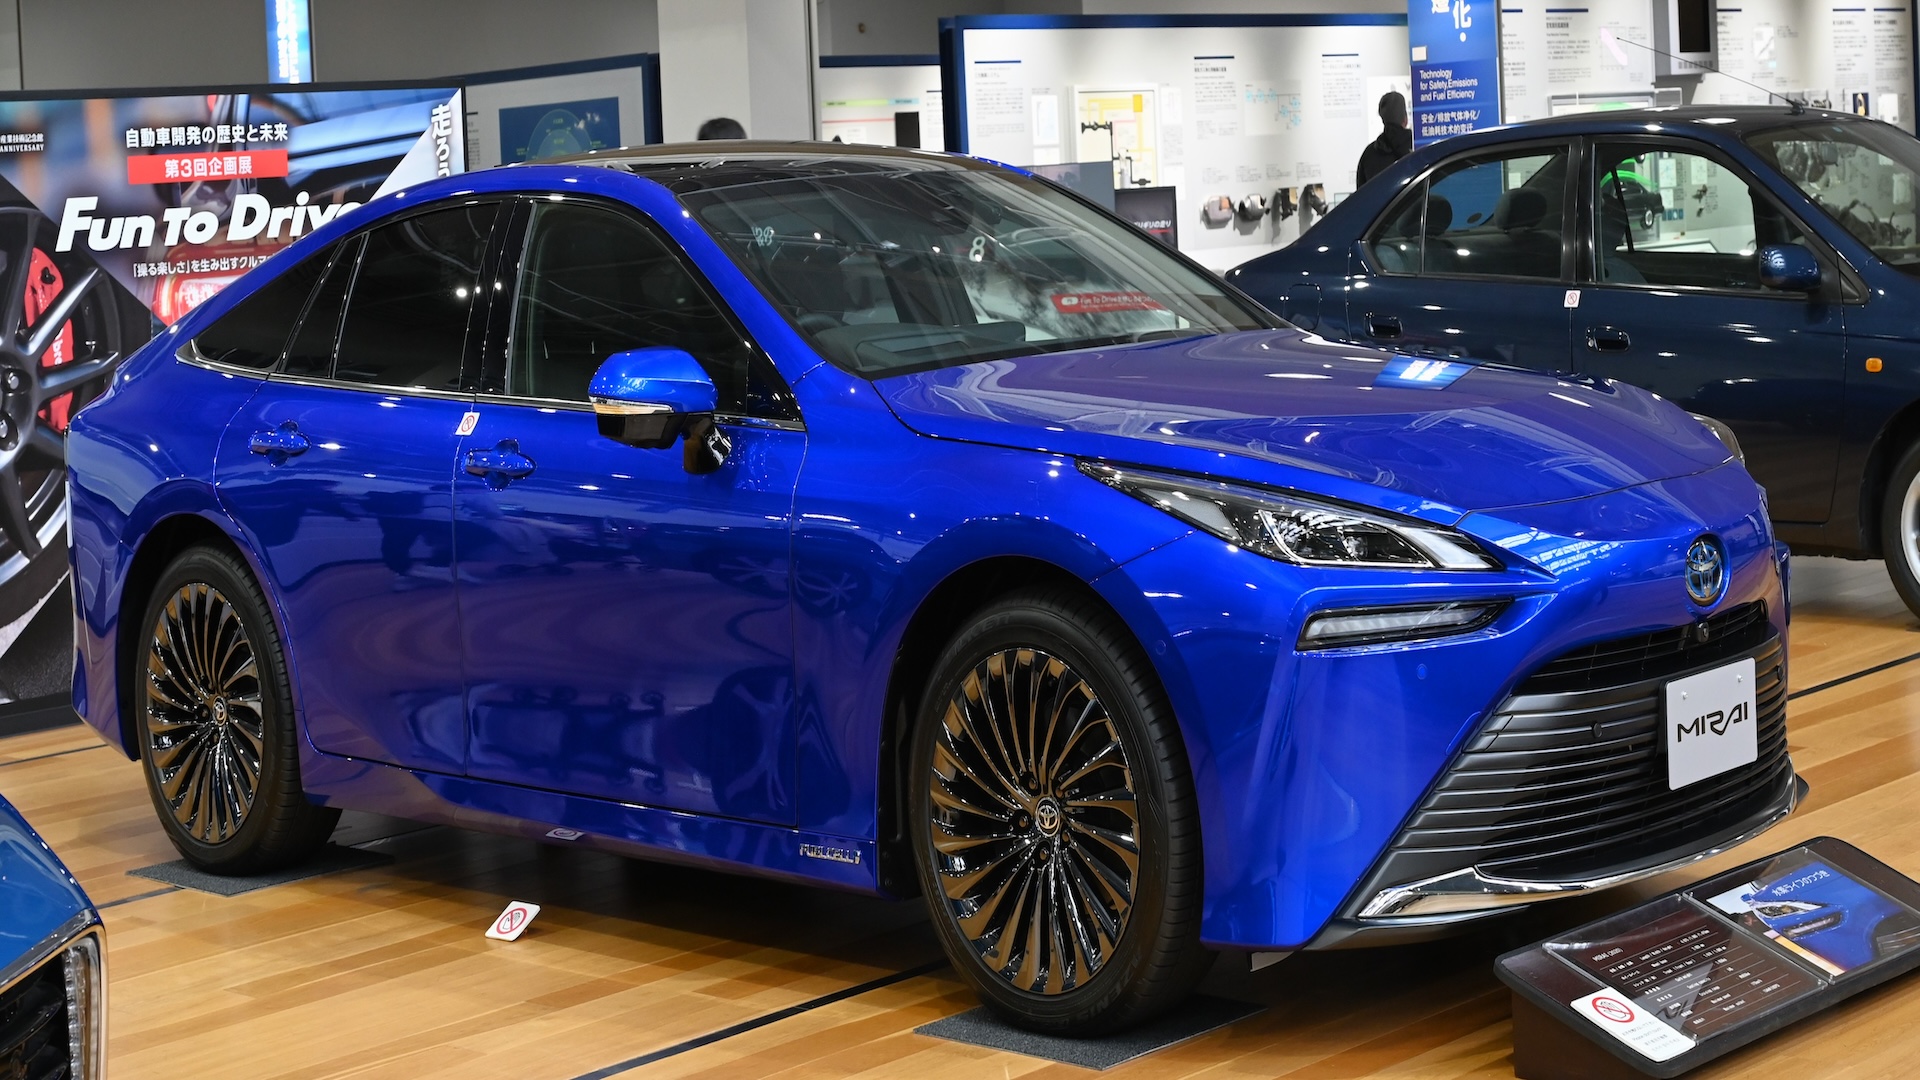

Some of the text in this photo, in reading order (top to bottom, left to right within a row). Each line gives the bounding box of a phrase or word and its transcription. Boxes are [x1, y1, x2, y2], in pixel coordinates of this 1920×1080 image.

[1420, 69, 1453, 80] Technology
[1420, 81, 1428, 91] for
[1420, 89, 1475, 102] and Fuel Efficiency
[125, 123, 288, 149] 自動車開発の歴史と未来
[164, 156, 253, 179] 第3回企画展
[55, 196, 156, 252] Fun
[163, 207, 219, 247] To
[133, 252, 275, 278] 「操る楽しさ」を生み出すクルマ
[1677, 701, 1748, 743] MIRAI
